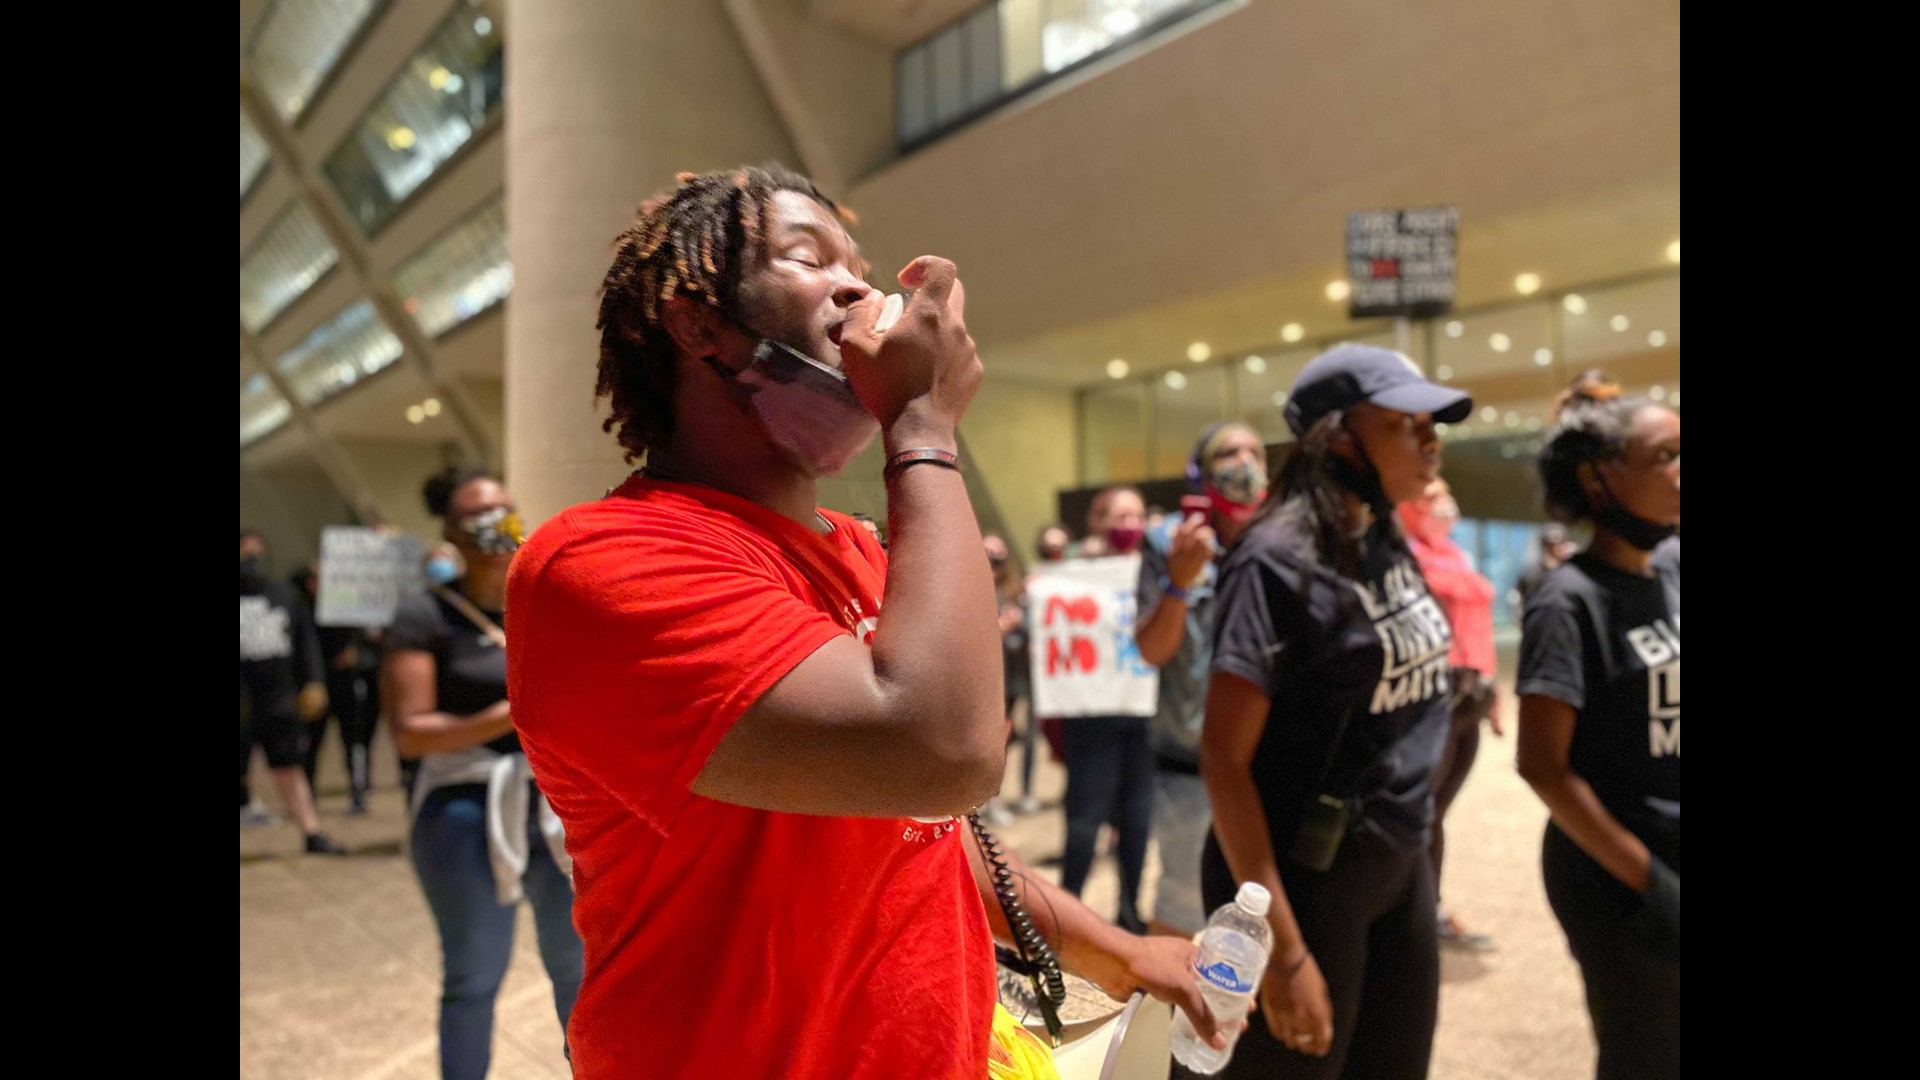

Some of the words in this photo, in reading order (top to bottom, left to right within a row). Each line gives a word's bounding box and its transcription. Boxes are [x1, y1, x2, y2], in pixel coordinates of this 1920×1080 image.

[1043, 595, 1100, 627] NO
[1045, 636, 1098, 677] NO
[1208, 968, 1237, 988] WATER
